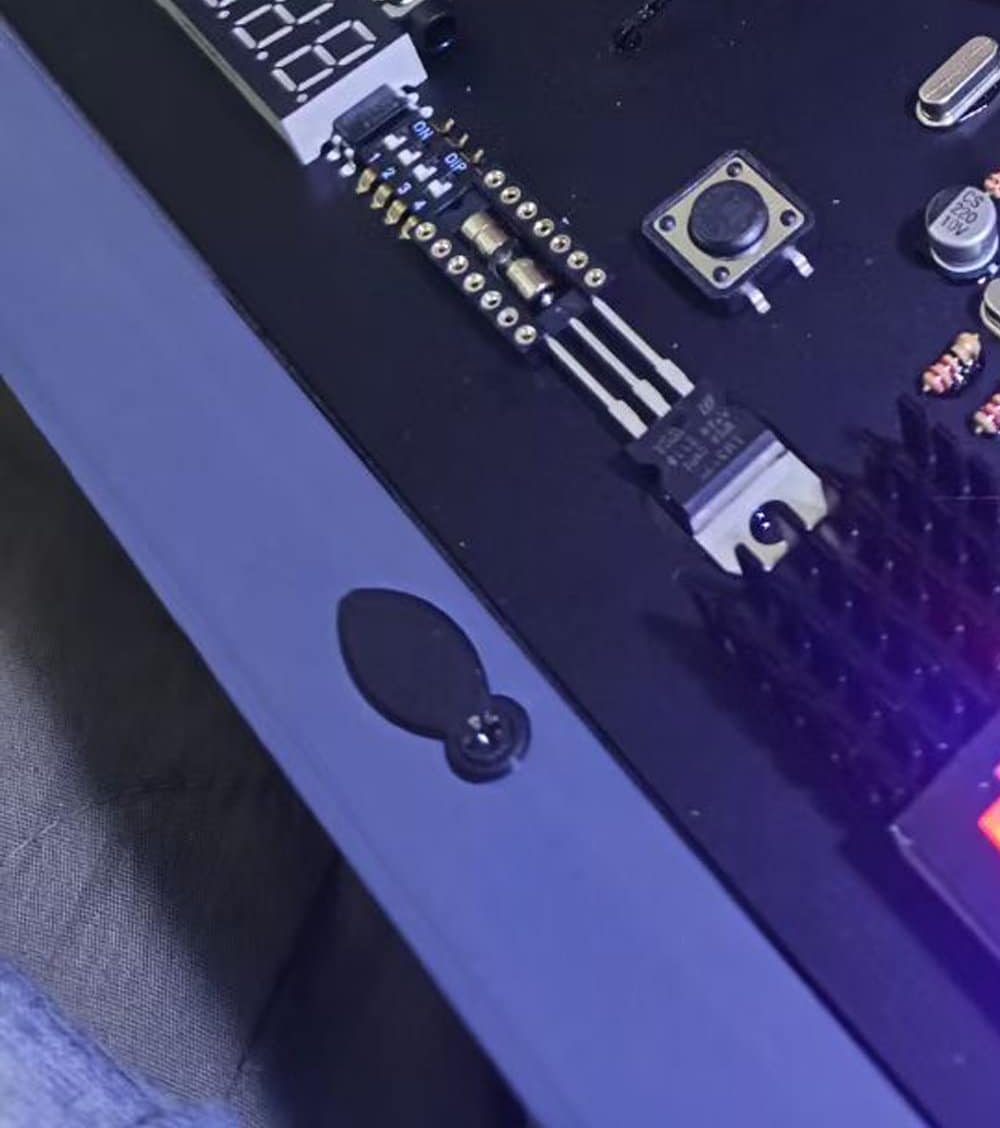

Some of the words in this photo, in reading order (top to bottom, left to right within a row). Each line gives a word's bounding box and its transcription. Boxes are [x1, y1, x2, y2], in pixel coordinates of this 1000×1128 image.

[413, 120, 435, 141] ON
[444, 152, 468, 173] DIP
[368, 152, 382, 163] 1
[381, 167, 396, 180] 2
[397, 182, 412, 195] 3
[413, 200, 427, 212] 4
[962, 190, 985, 208] CS
[950, 202, 978, 224] 220
[941, 215, 969, 236] 10V
